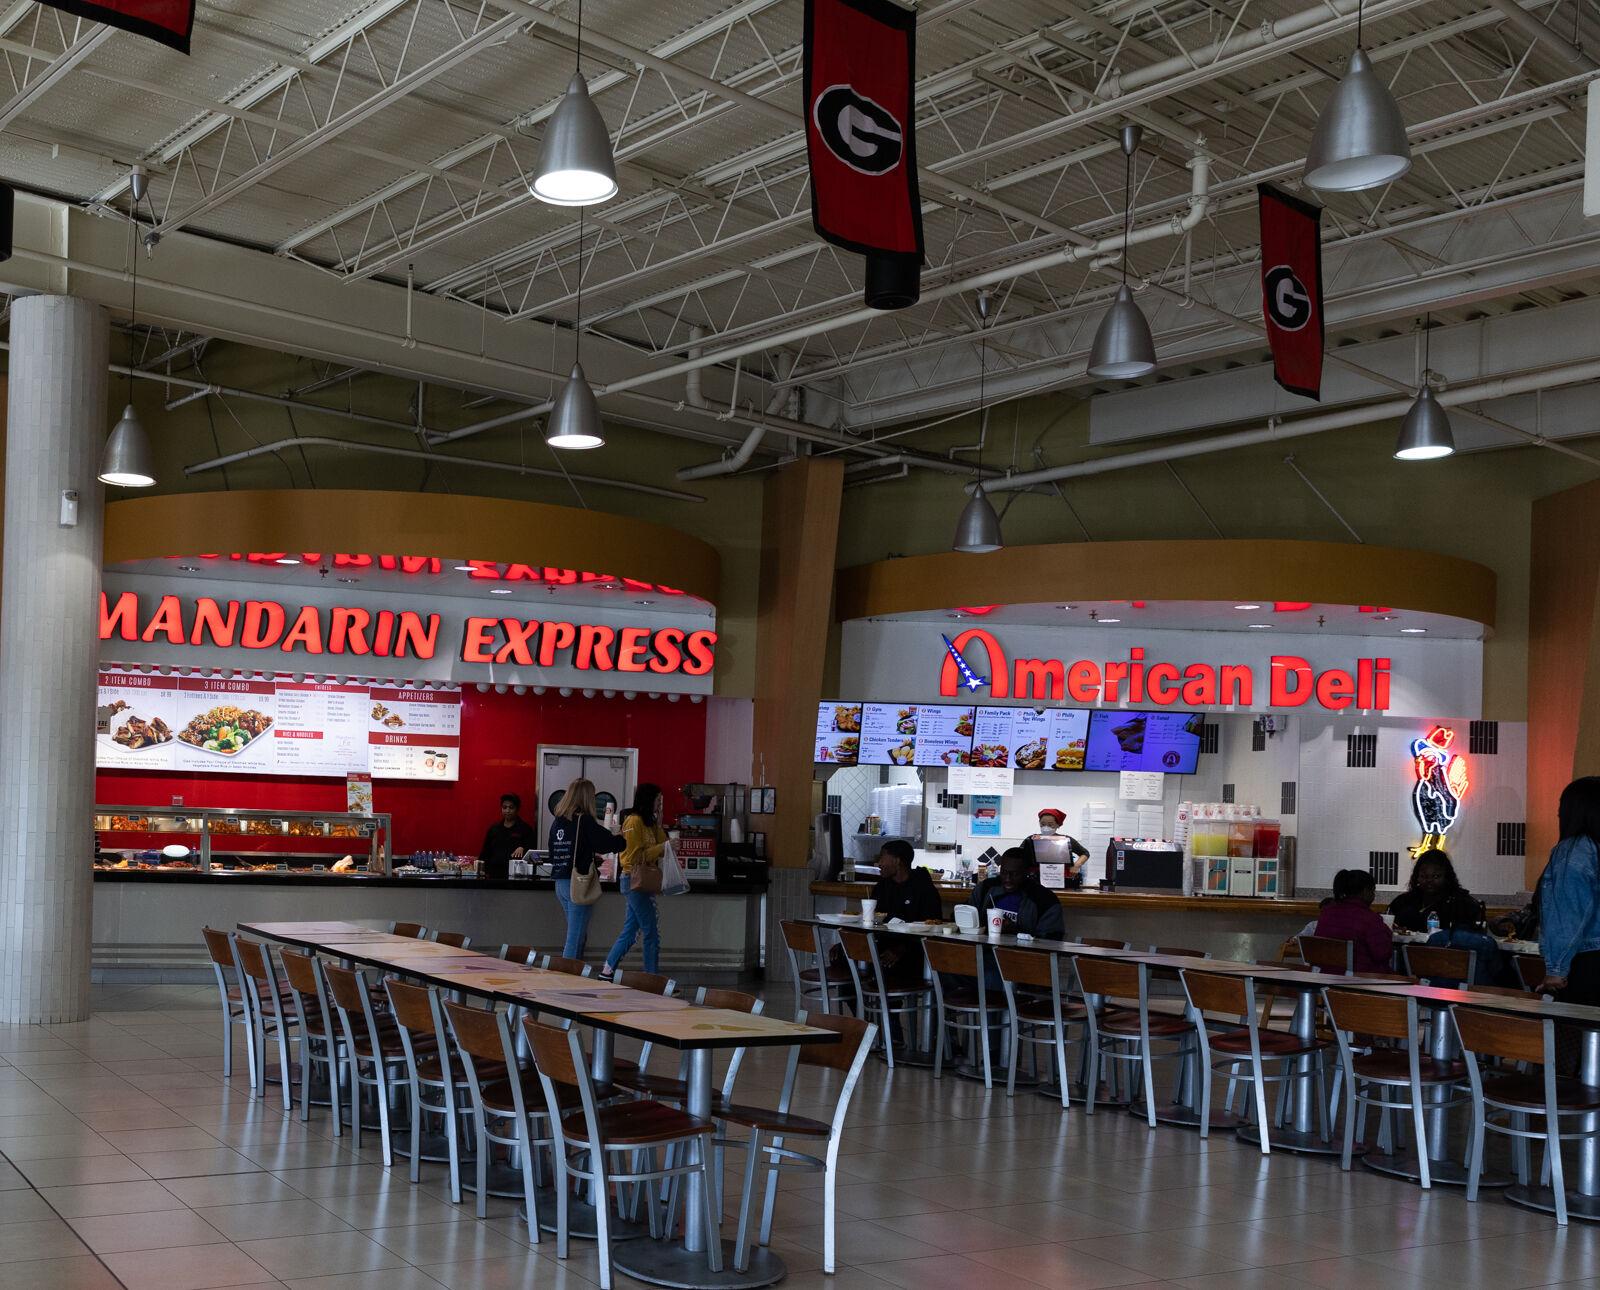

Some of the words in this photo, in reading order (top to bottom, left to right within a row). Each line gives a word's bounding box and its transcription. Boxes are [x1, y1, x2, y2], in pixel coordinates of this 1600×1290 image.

[98, 591, 441, 660] MANDARIN
[461, 617, 717, 676] EXPRESS
[940, 628, 1254, 706] American
[1270, 656, 1391, 711] Deli
[105, 675, 109, 684] 2
[111, 676, 127, 685] ITEM
[128, 677, 152, 686] COMBO
[204, 681, 209, 689] 3
[210, 681, 226, 690] ITEM
[228, 682, 250, 691] COMBO
[398, 691, 434, 701] APPETIZERS
[384, 734, 408, 744] DRINKS
[682, 840, 710, 849] DELIVERY
